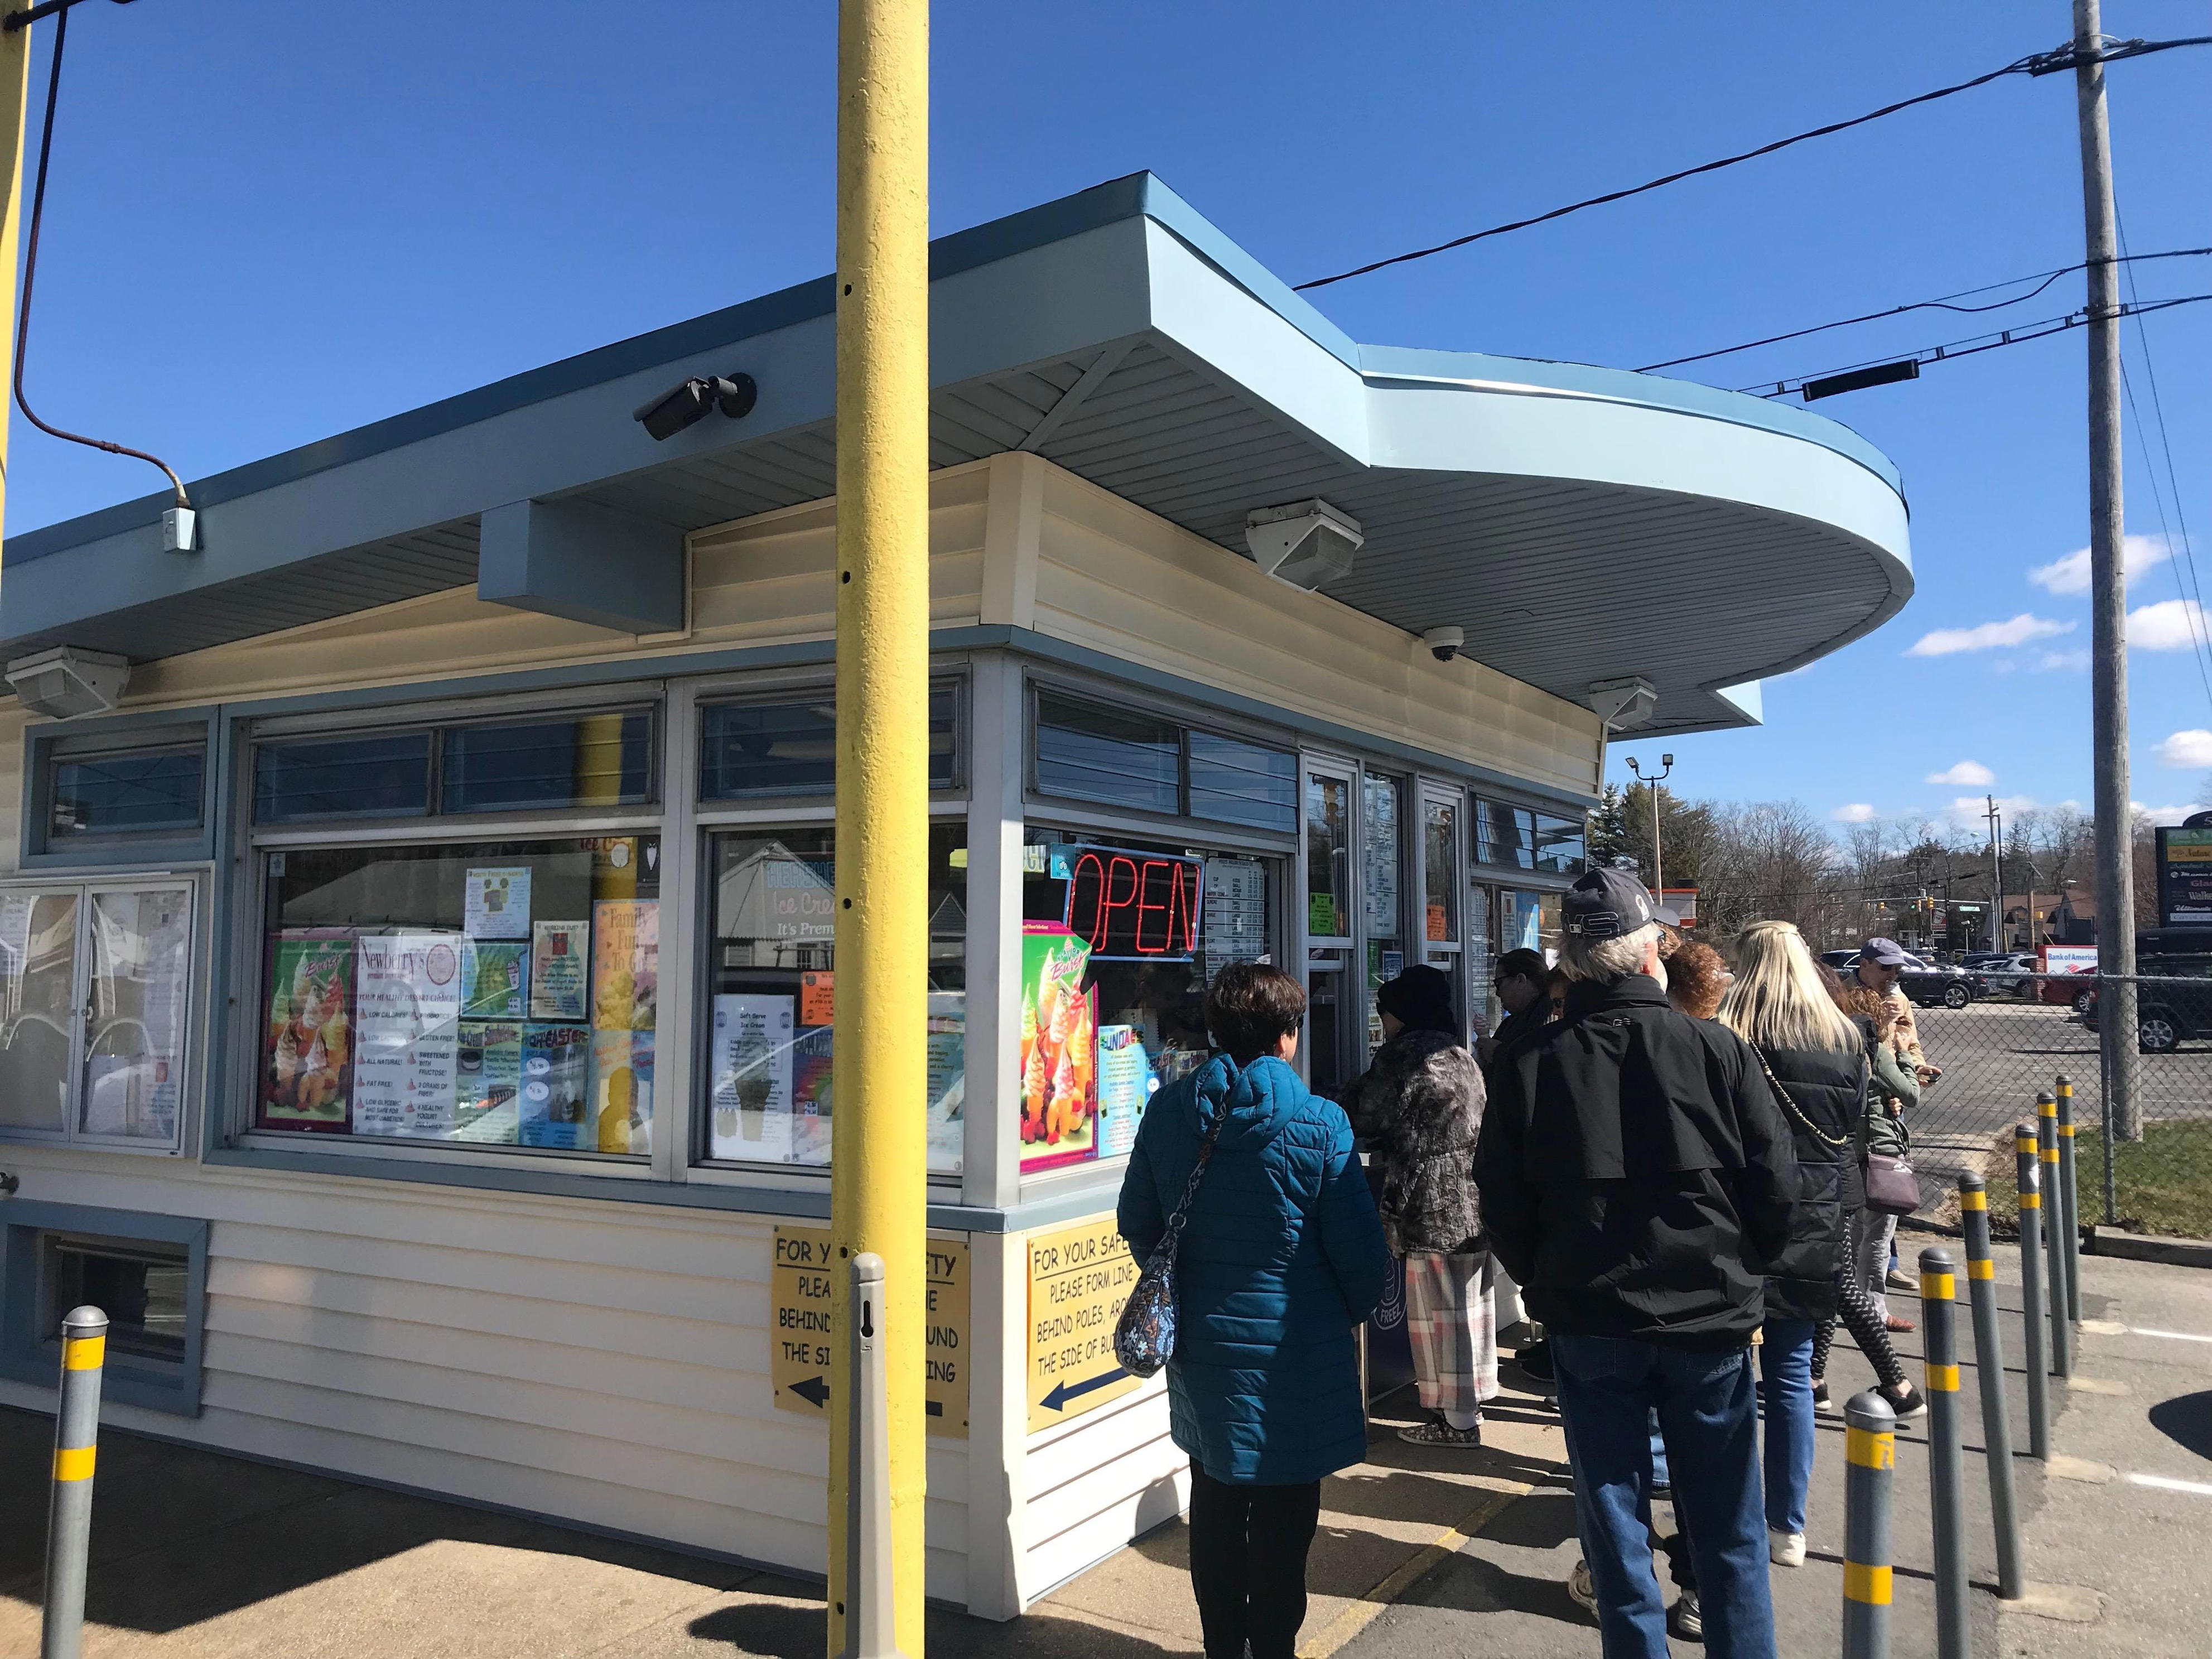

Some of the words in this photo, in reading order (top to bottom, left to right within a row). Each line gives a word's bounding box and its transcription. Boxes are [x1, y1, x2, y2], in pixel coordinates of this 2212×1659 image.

[767, 861, 835, 888] HERSHE
[773, 891, 798, 915] Ice
[1068, 853, 1199, 952] OPEN
[2189, 891, 2212, 900] Walke
[610, 907, 647, 933] Family
[778, 923, 797, 935] It's
[800, 922, 835, 935] Prem
[618, 929, 639, 949] Fun
[305, 951, 345, 977] Burst
[363, 943, 425, 980] Newberry's
[612, 952, 625, 972] To
[1050, 951, 1090, 981] Burst
[359, 992, 375, 1001] YOUR
[1100, 1028, 1144, 1051] SUNDAES
[777, 1238, 812, 1261] FOR
[1034, 1247, 1058, 1274] FOR
[1064, 1238, 1096, 1265] YOUR
[799, 1276, 831, 1298] PLEA
[1050, 1277, 1083, 1304] PLEASE
[1087, 1269, 1110, 1294] FORM
[1114, 1262, 1133, 1286] LINE
[1037, 1315, 1072, 1343] BEHIND
[1076, 1305, 1105, 1330] POLES,
[1110, 1297, 1129, 1319] ARO
[1380, 1303, 1401, 1323] FREEZ
[782, 1341, 809, 1363] THE
[815, 1347, 831, 1366] SI
[1038, 1352, 1057, 1376] THE
[1059, 1343, 1083, 1369] SIDE
[1086, 1338, 1098, 1360] OF
[1101, 1332, 1116, 1355] BUI
